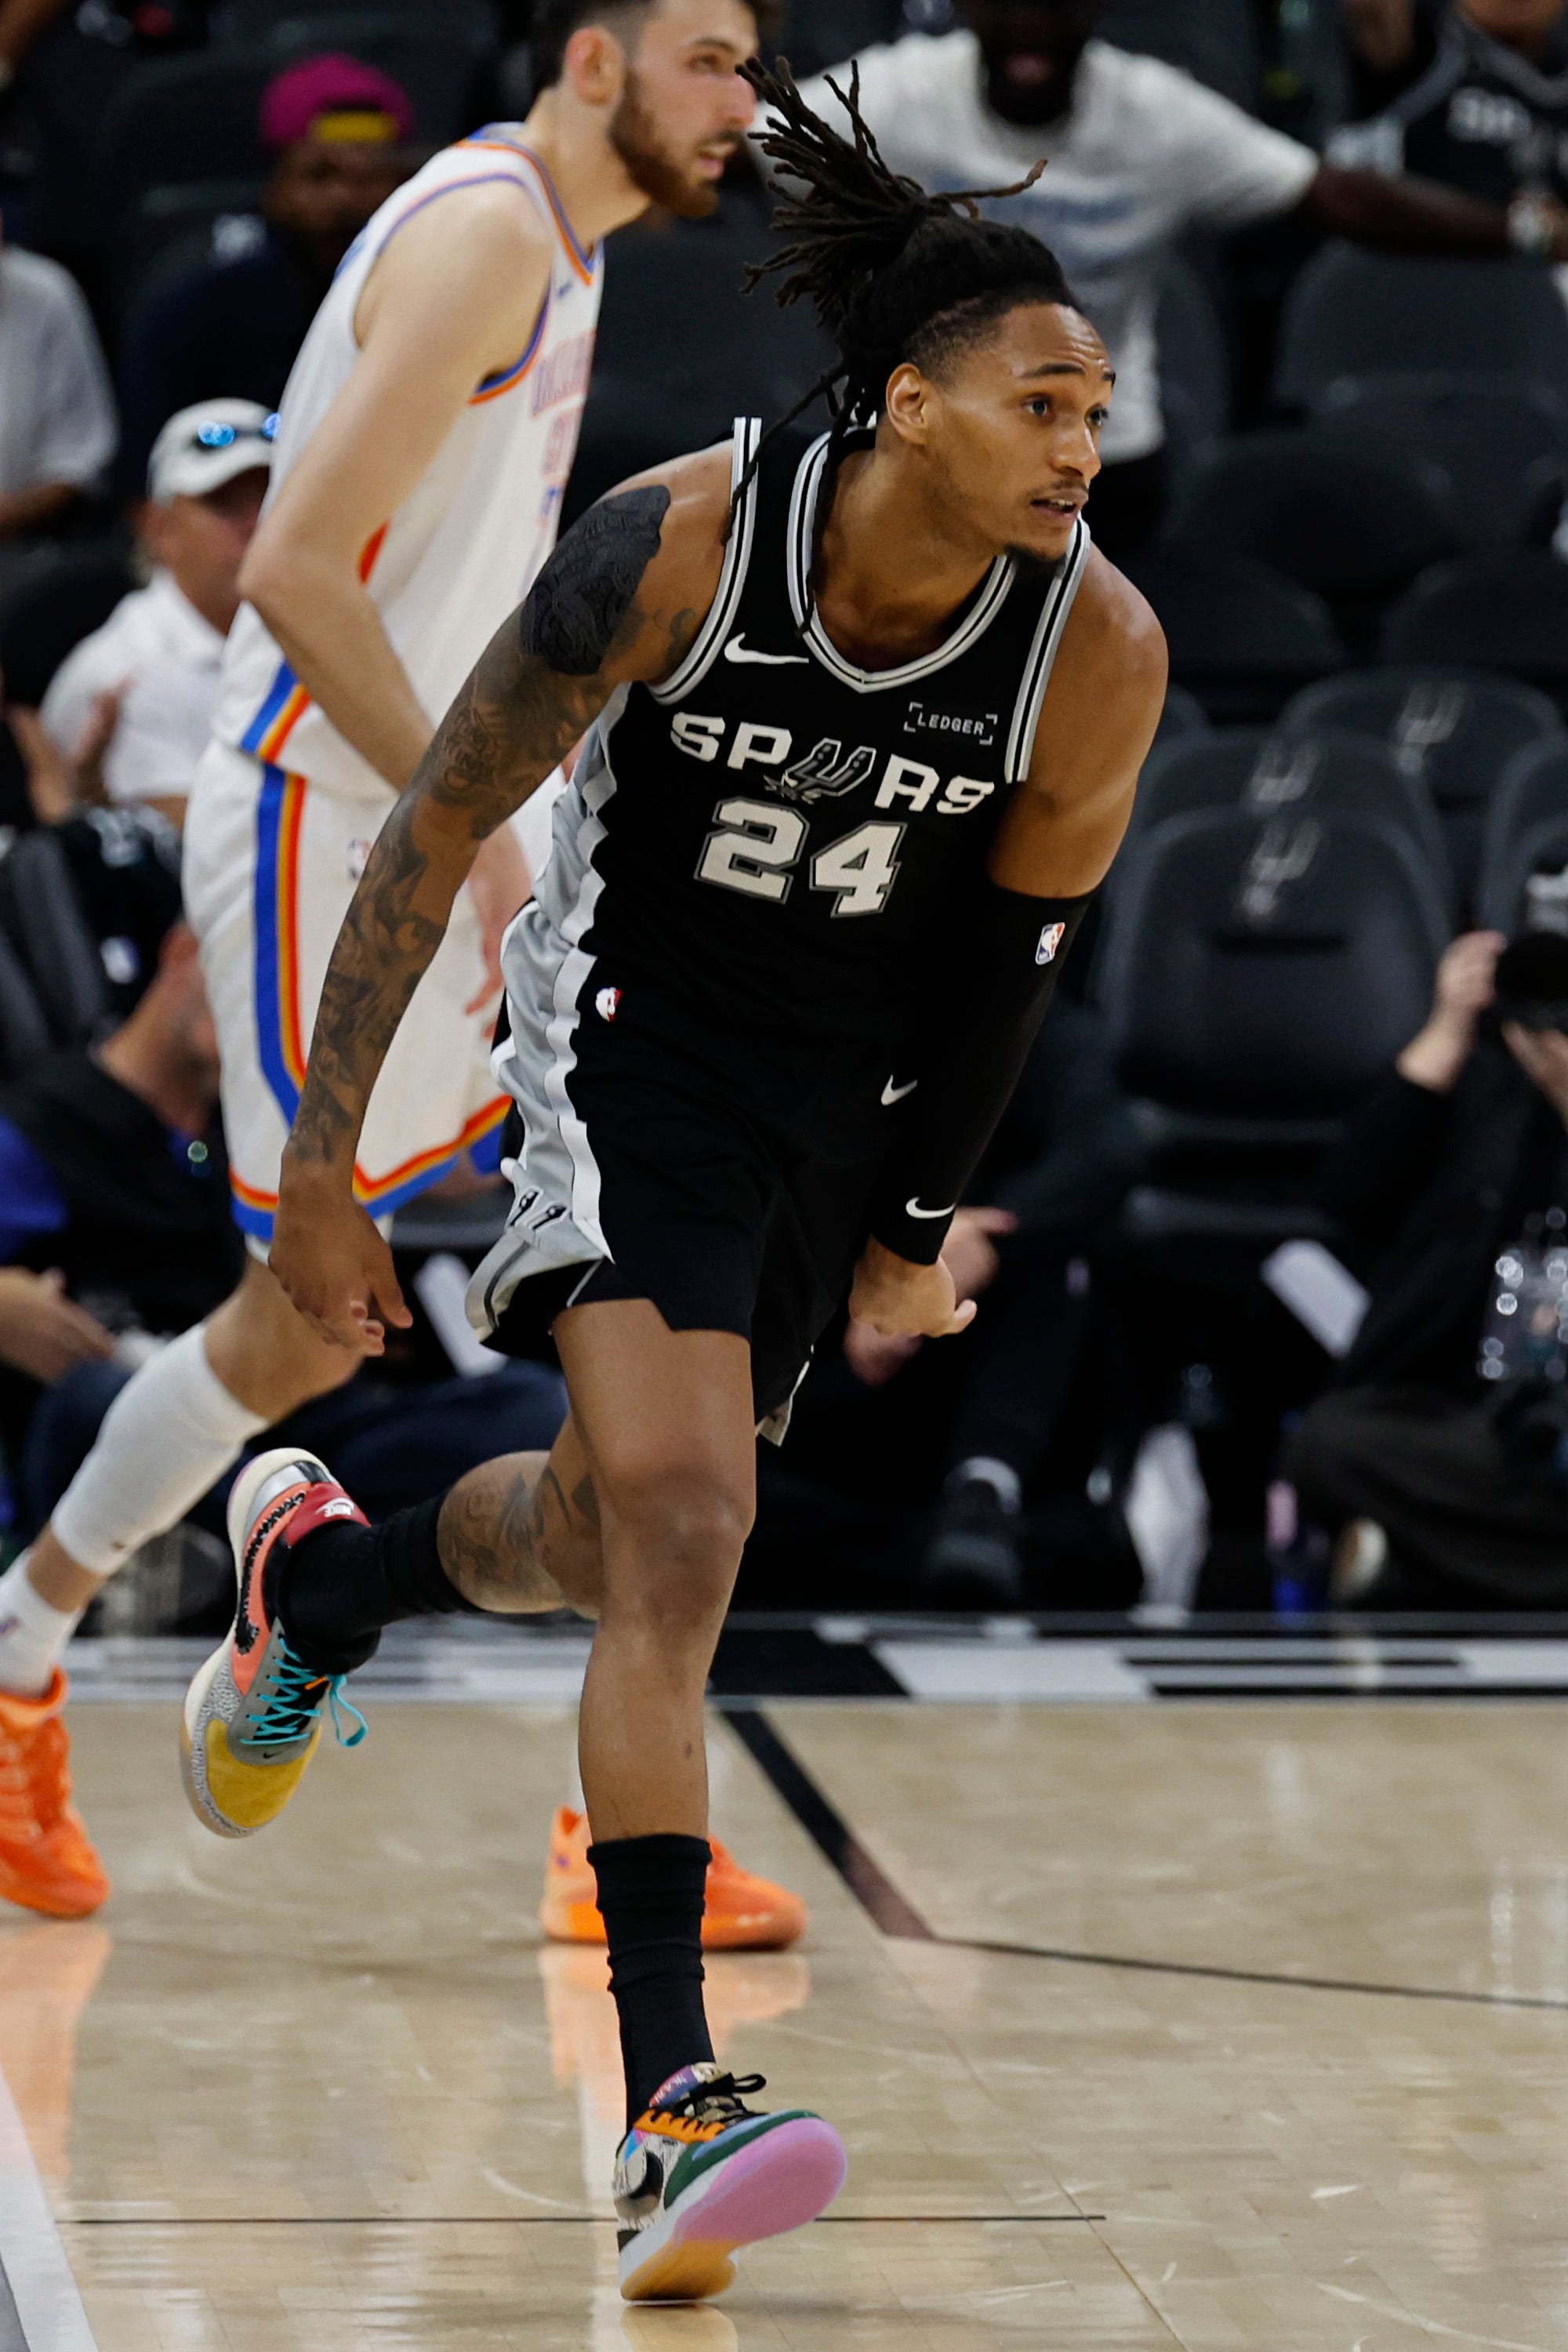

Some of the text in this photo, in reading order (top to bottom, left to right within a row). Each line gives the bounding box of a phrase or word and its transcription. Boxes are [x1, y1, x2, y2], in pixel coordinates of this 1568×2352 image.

[670, 711, 995, 815] SPURS
[917, 712, 985, 736] LEDGER
[693, 796, 909, 919] 24
